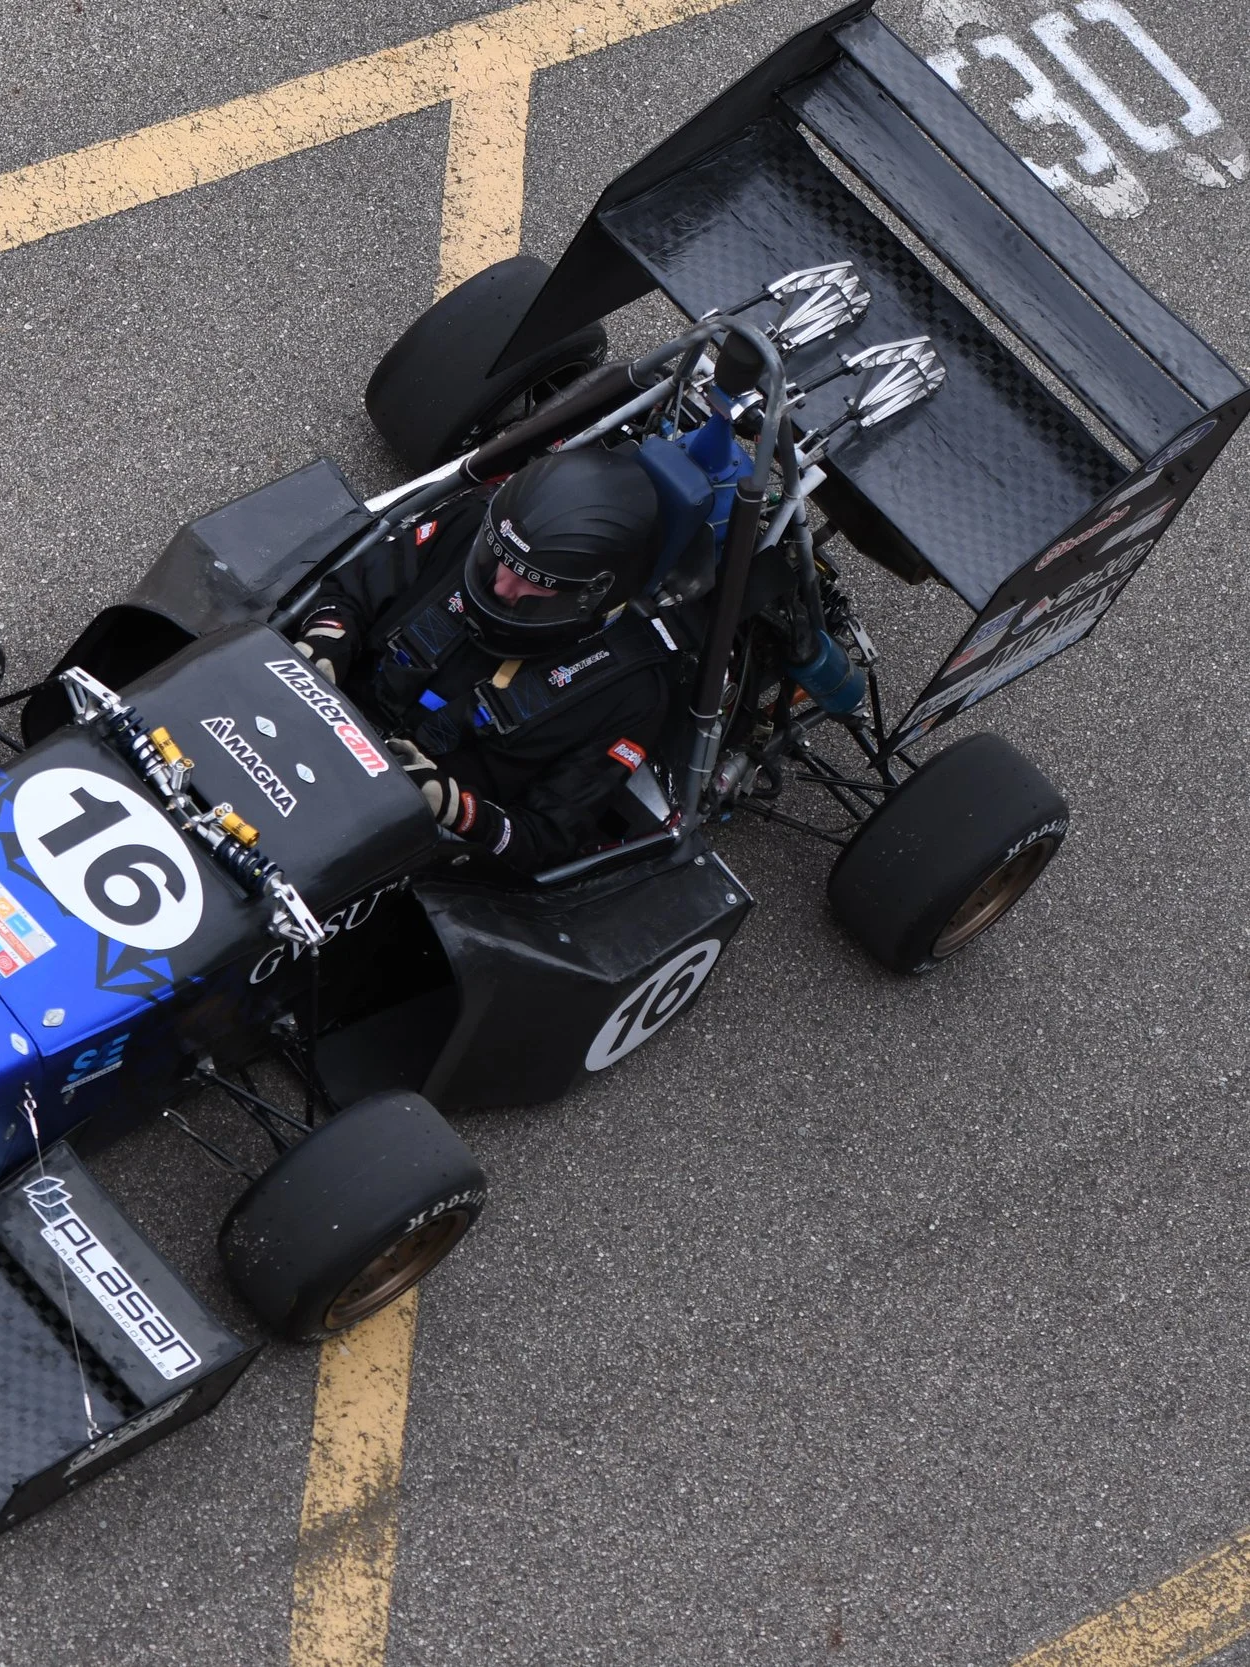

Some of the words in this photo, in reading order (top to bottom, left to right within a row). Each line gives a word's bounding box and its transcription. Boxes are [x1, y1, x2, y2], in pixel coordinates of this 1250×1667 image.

[985, 574, 1130, 673] MIDWAY
[1047, 538, 1154, 613] ClickUp
[267, 660, 388, 776] Mastercam
[224, 735, 295, 815] MAGNA
[38, 786, 186, 926] 16
[605, 950, 708, 1057] 16
[98, 1294, 174, 1379] COMPOSITES
